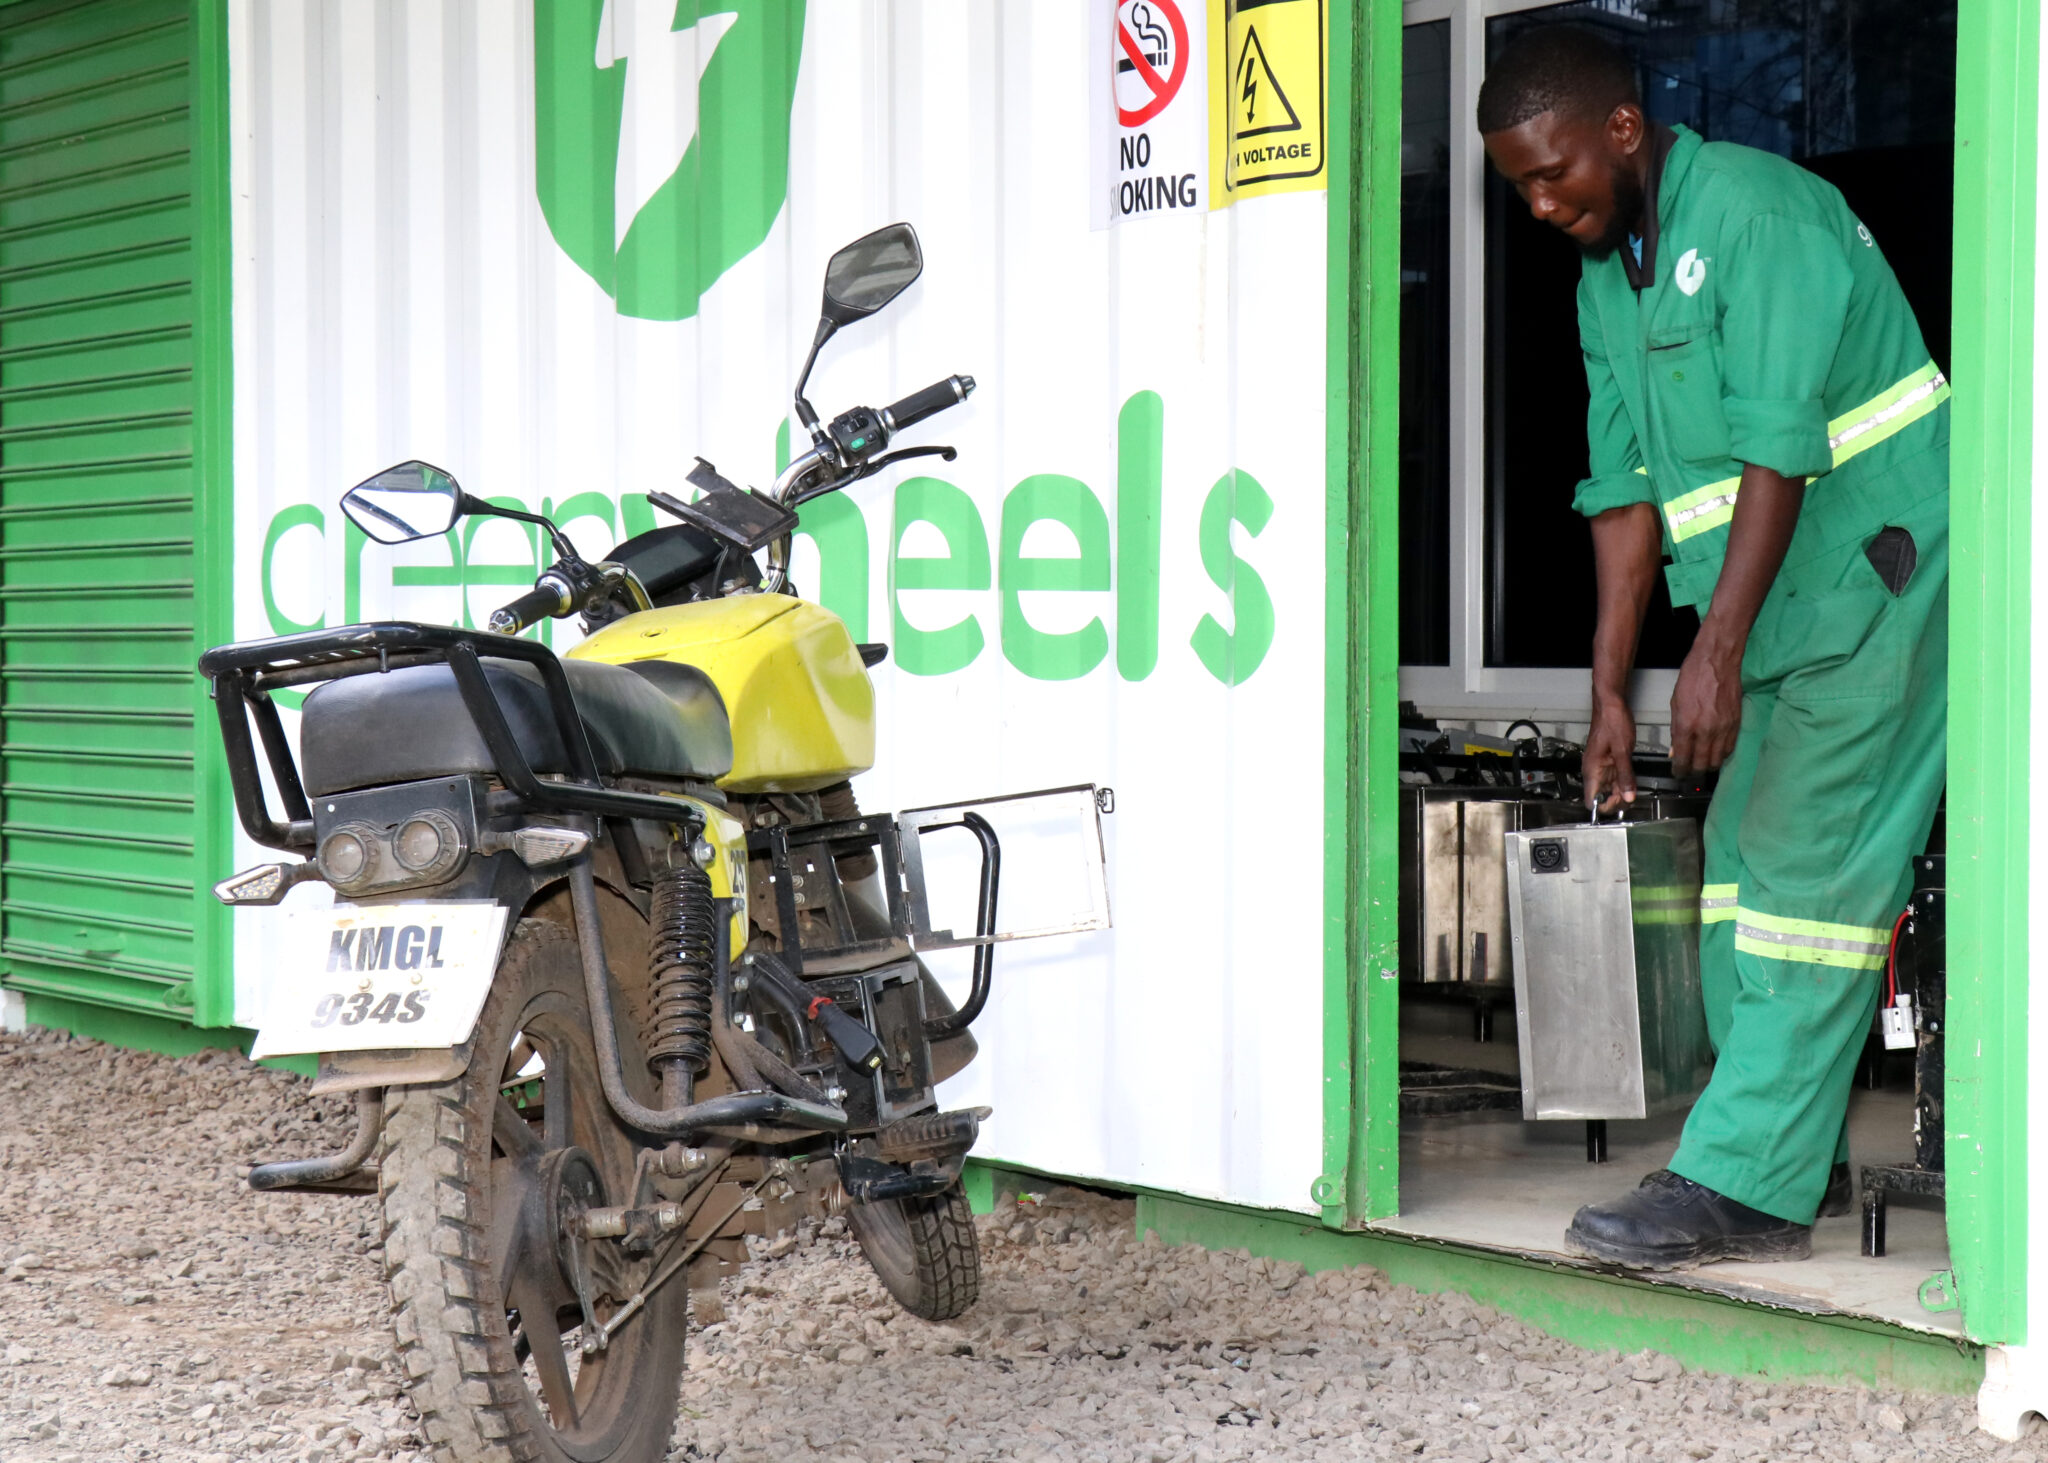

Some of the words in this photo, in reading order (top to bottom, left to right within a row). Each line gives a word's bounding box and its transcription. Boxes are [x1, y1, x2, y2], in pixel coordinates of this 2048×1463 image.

[1120, 133, 1151, 171] NO
[1243, 143, 1312, 166] VOLTAGE
[326, 925, 444, 973] KMGL
[310, 989, 432, 1029] 934S
